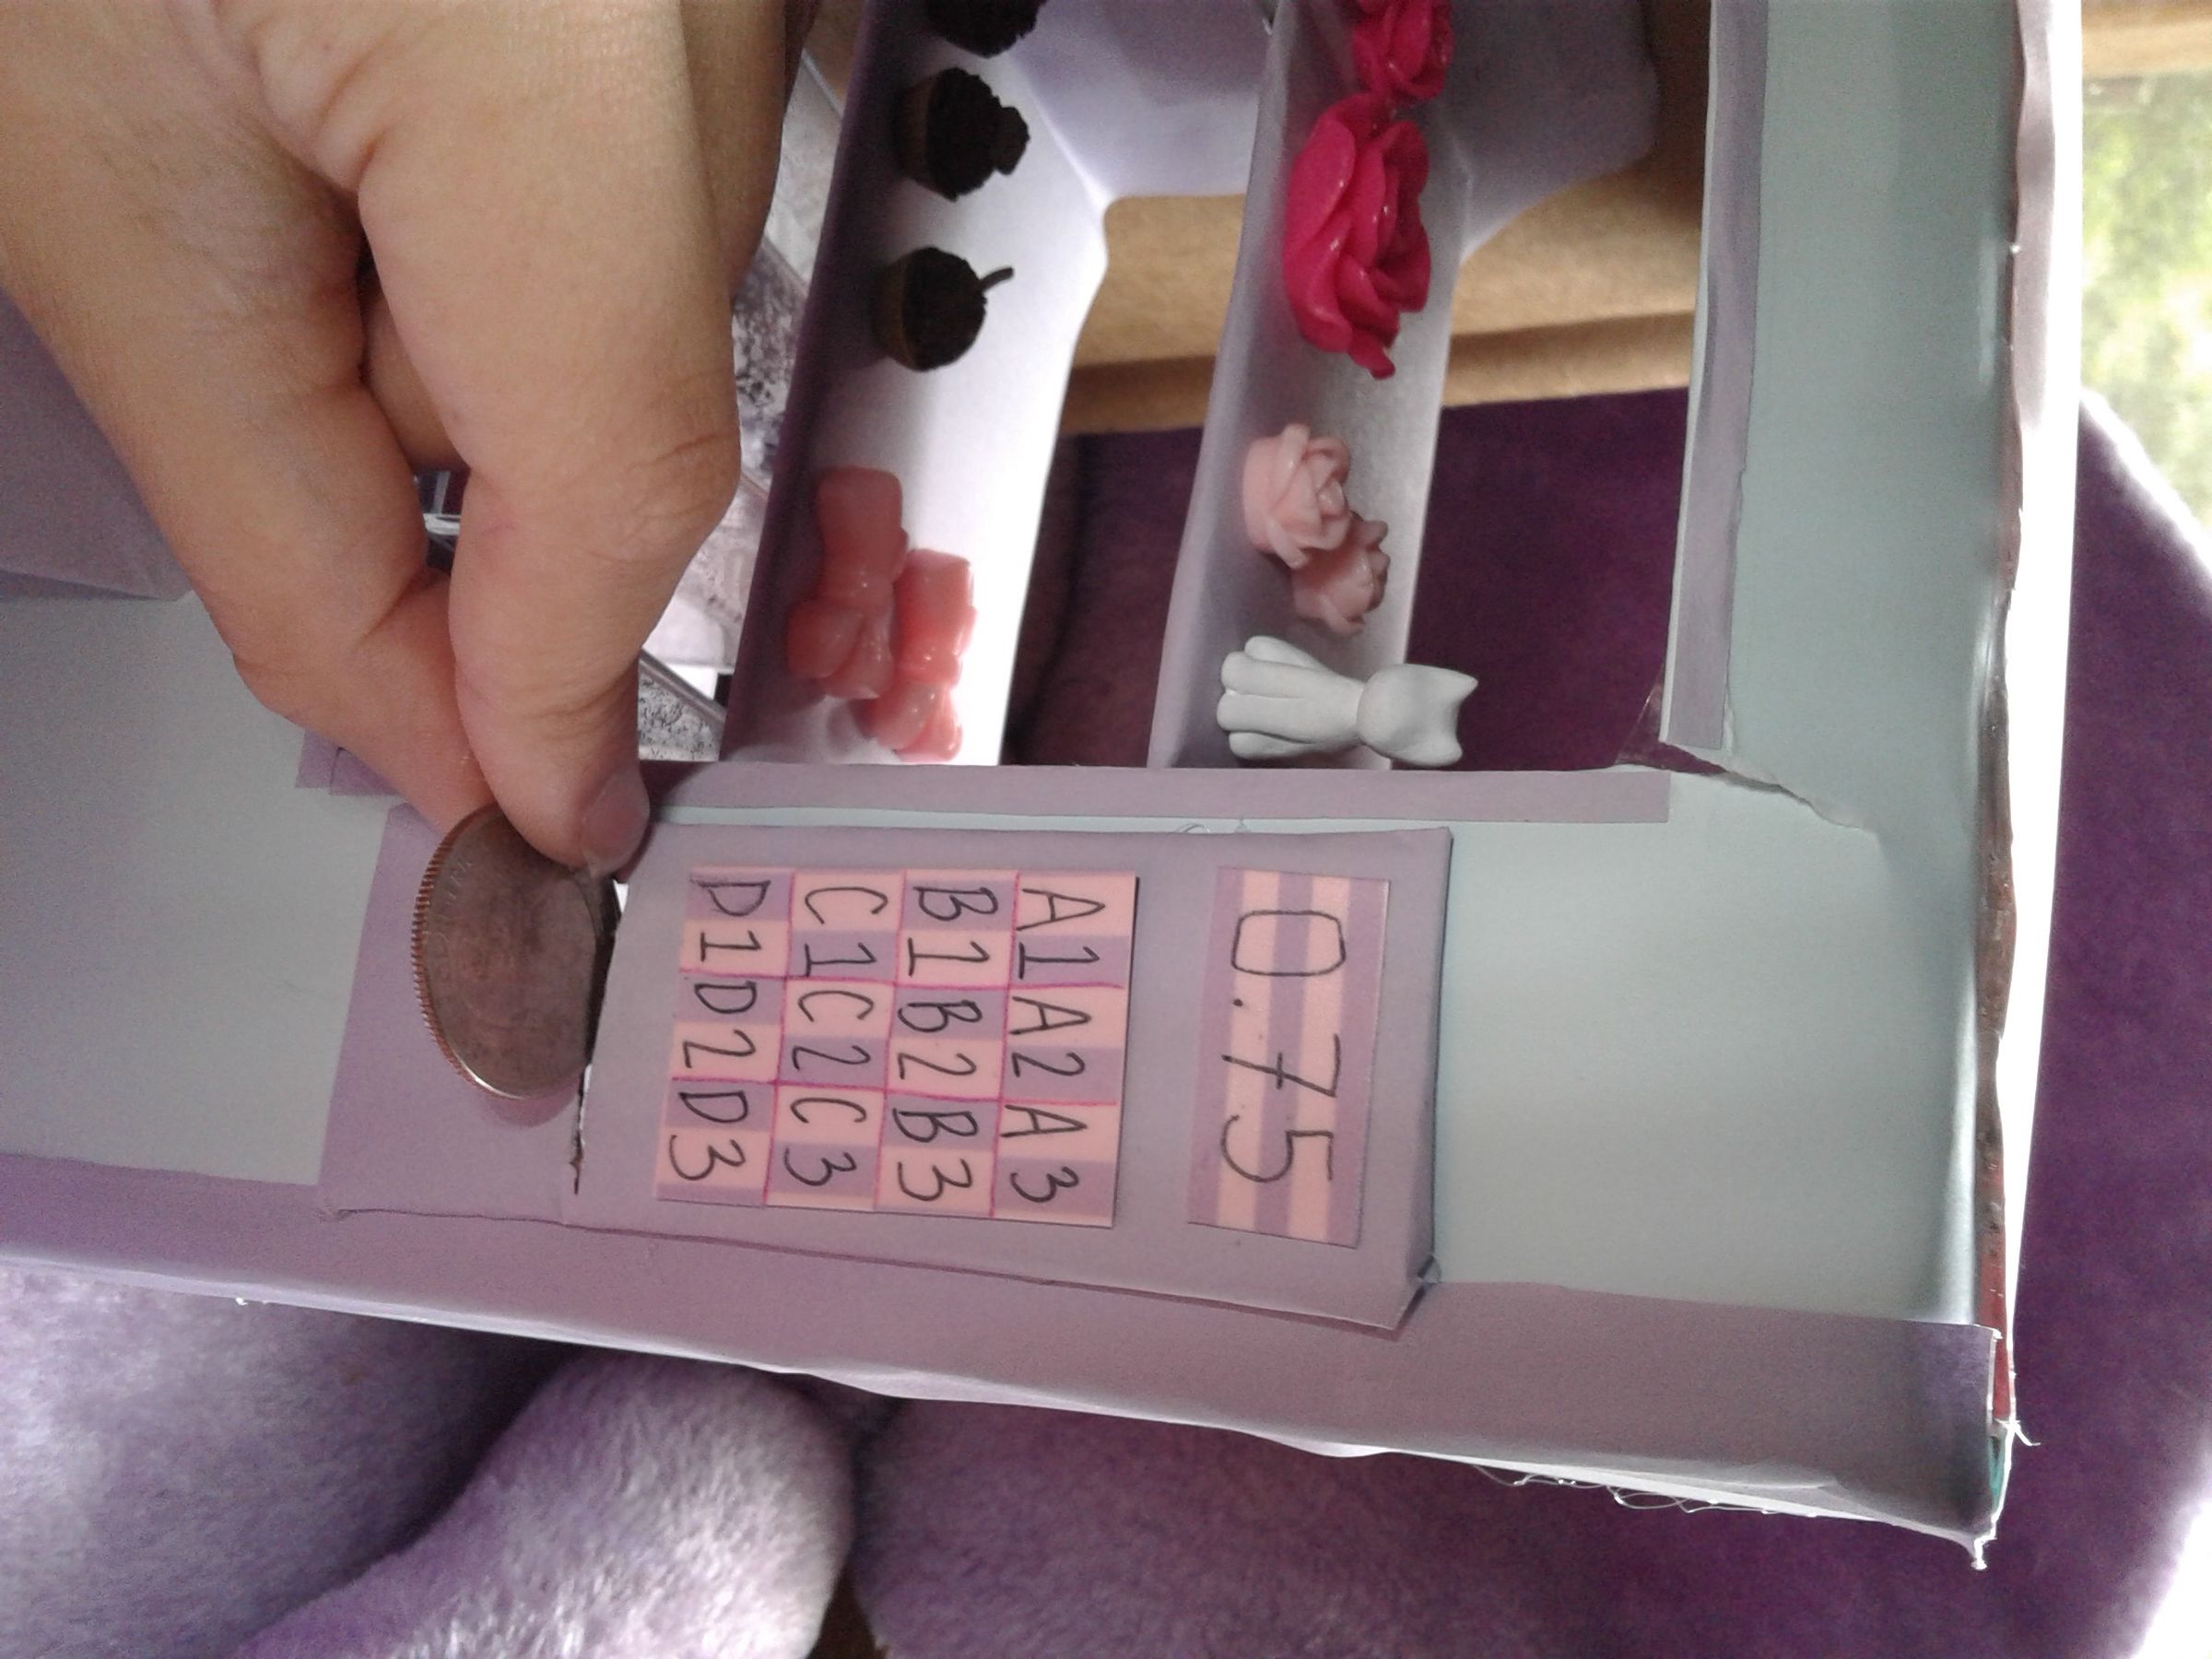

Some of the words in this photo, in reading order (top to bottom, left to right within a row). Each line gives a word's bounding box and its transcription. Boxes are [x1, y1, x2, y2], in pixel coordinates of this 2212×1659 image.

[689, 877, 771, 962] D1
[804, 886, 888, 977] C1
[906, 886, 999, 977] B1
[1017, 888, 1106, 980] A1
[683, 981, 758, 1068] D2
[792, 990, 875, 1070] C2
[897, 999, 983, 1079] B2
[1009, 995, 1092, 1077] A2
[1220, 910, 1346, 1182] 0.75
[669, 1090, 749, 1181] D3
[784, 1096, 867, 1187] C3
[892, 1107, 980, 1201] B3
[1000, 1104, 1088, 1203] A3
